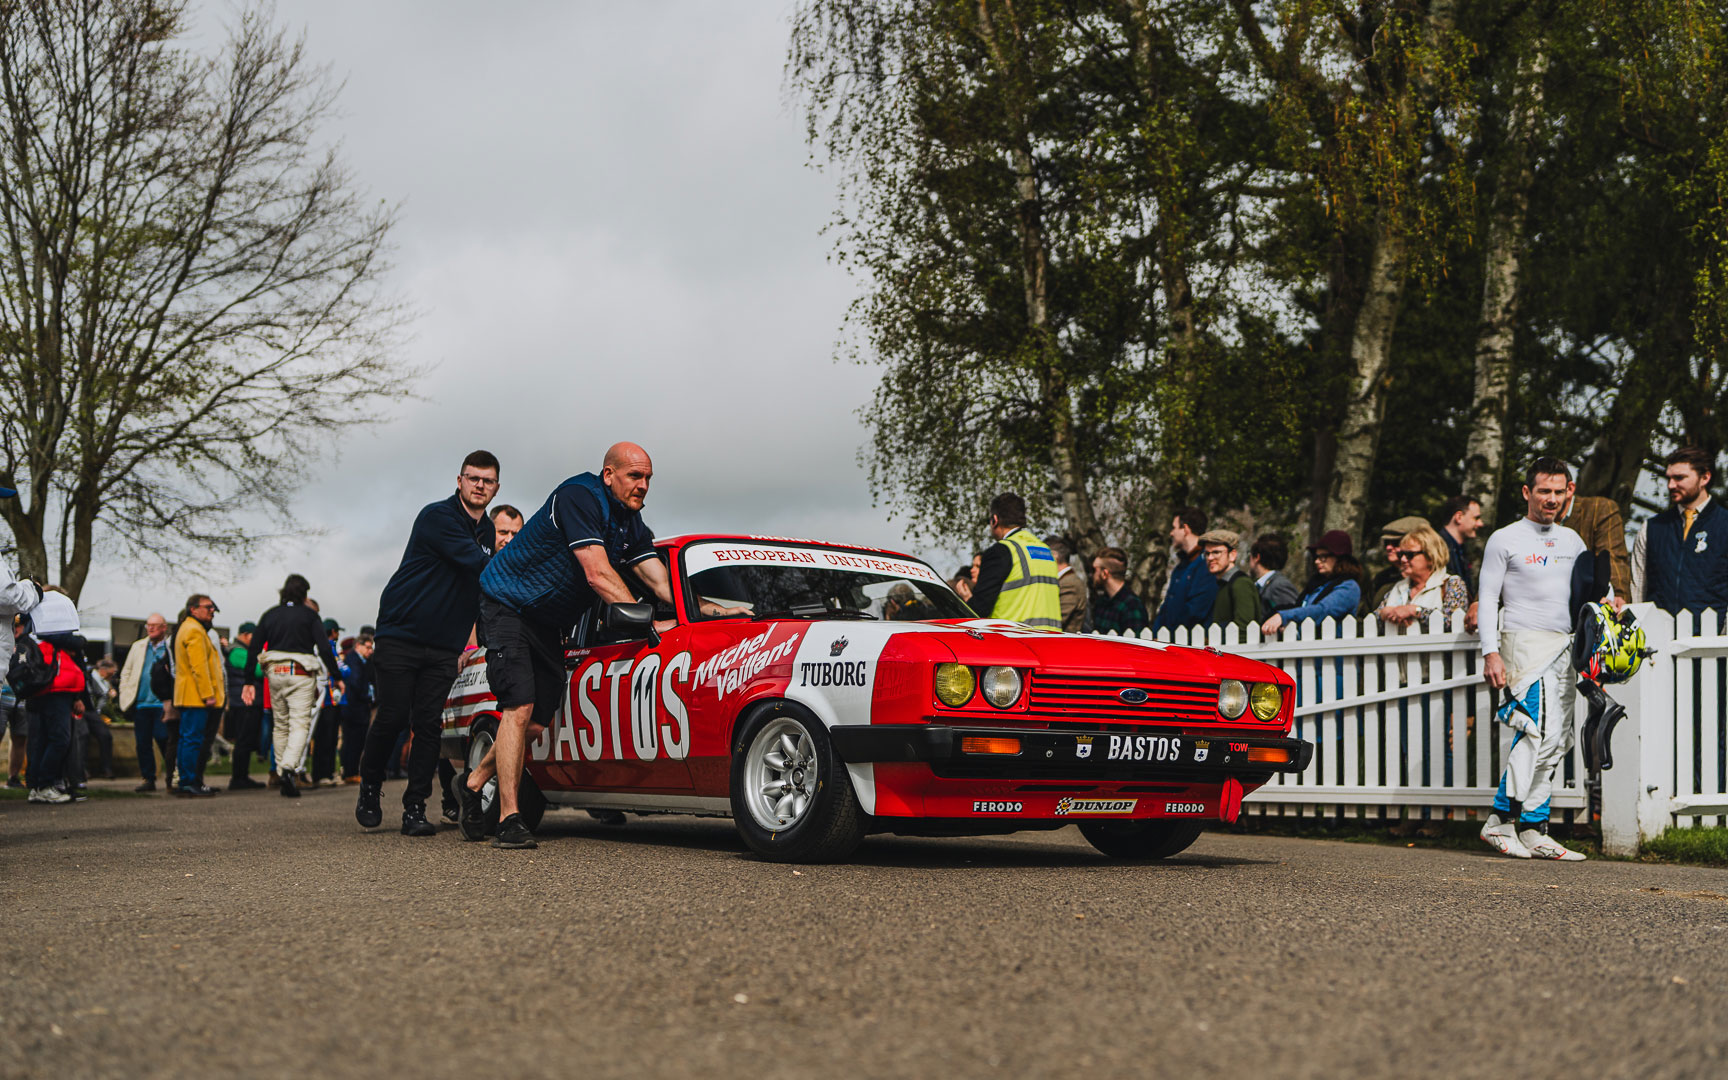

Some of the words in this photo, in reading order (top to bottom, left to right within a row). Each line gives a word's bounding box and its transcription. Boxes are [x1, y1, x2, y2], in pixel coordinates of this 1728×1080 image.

[713, 550, 816, 564] EUROPEAN
[823, 553, 935, 580] UNIVERSITY
[1525, 553, 1548, 567] sky
[692, 622, 778, 692] Michel
[717, 632, 799, 701] Vaillant
[800, 660, 866, 687] TUBORG
[633, 665, 657, 749] 11
[1107, 735, 1181, 761] BASTOS
[1228, 742, 1249, 753] TOW
[973, 801, 1023, 812] FERODO
[1071, 801, 1133, 811] DUNLOP
[1165, 802, 1205, 813] FERODO
